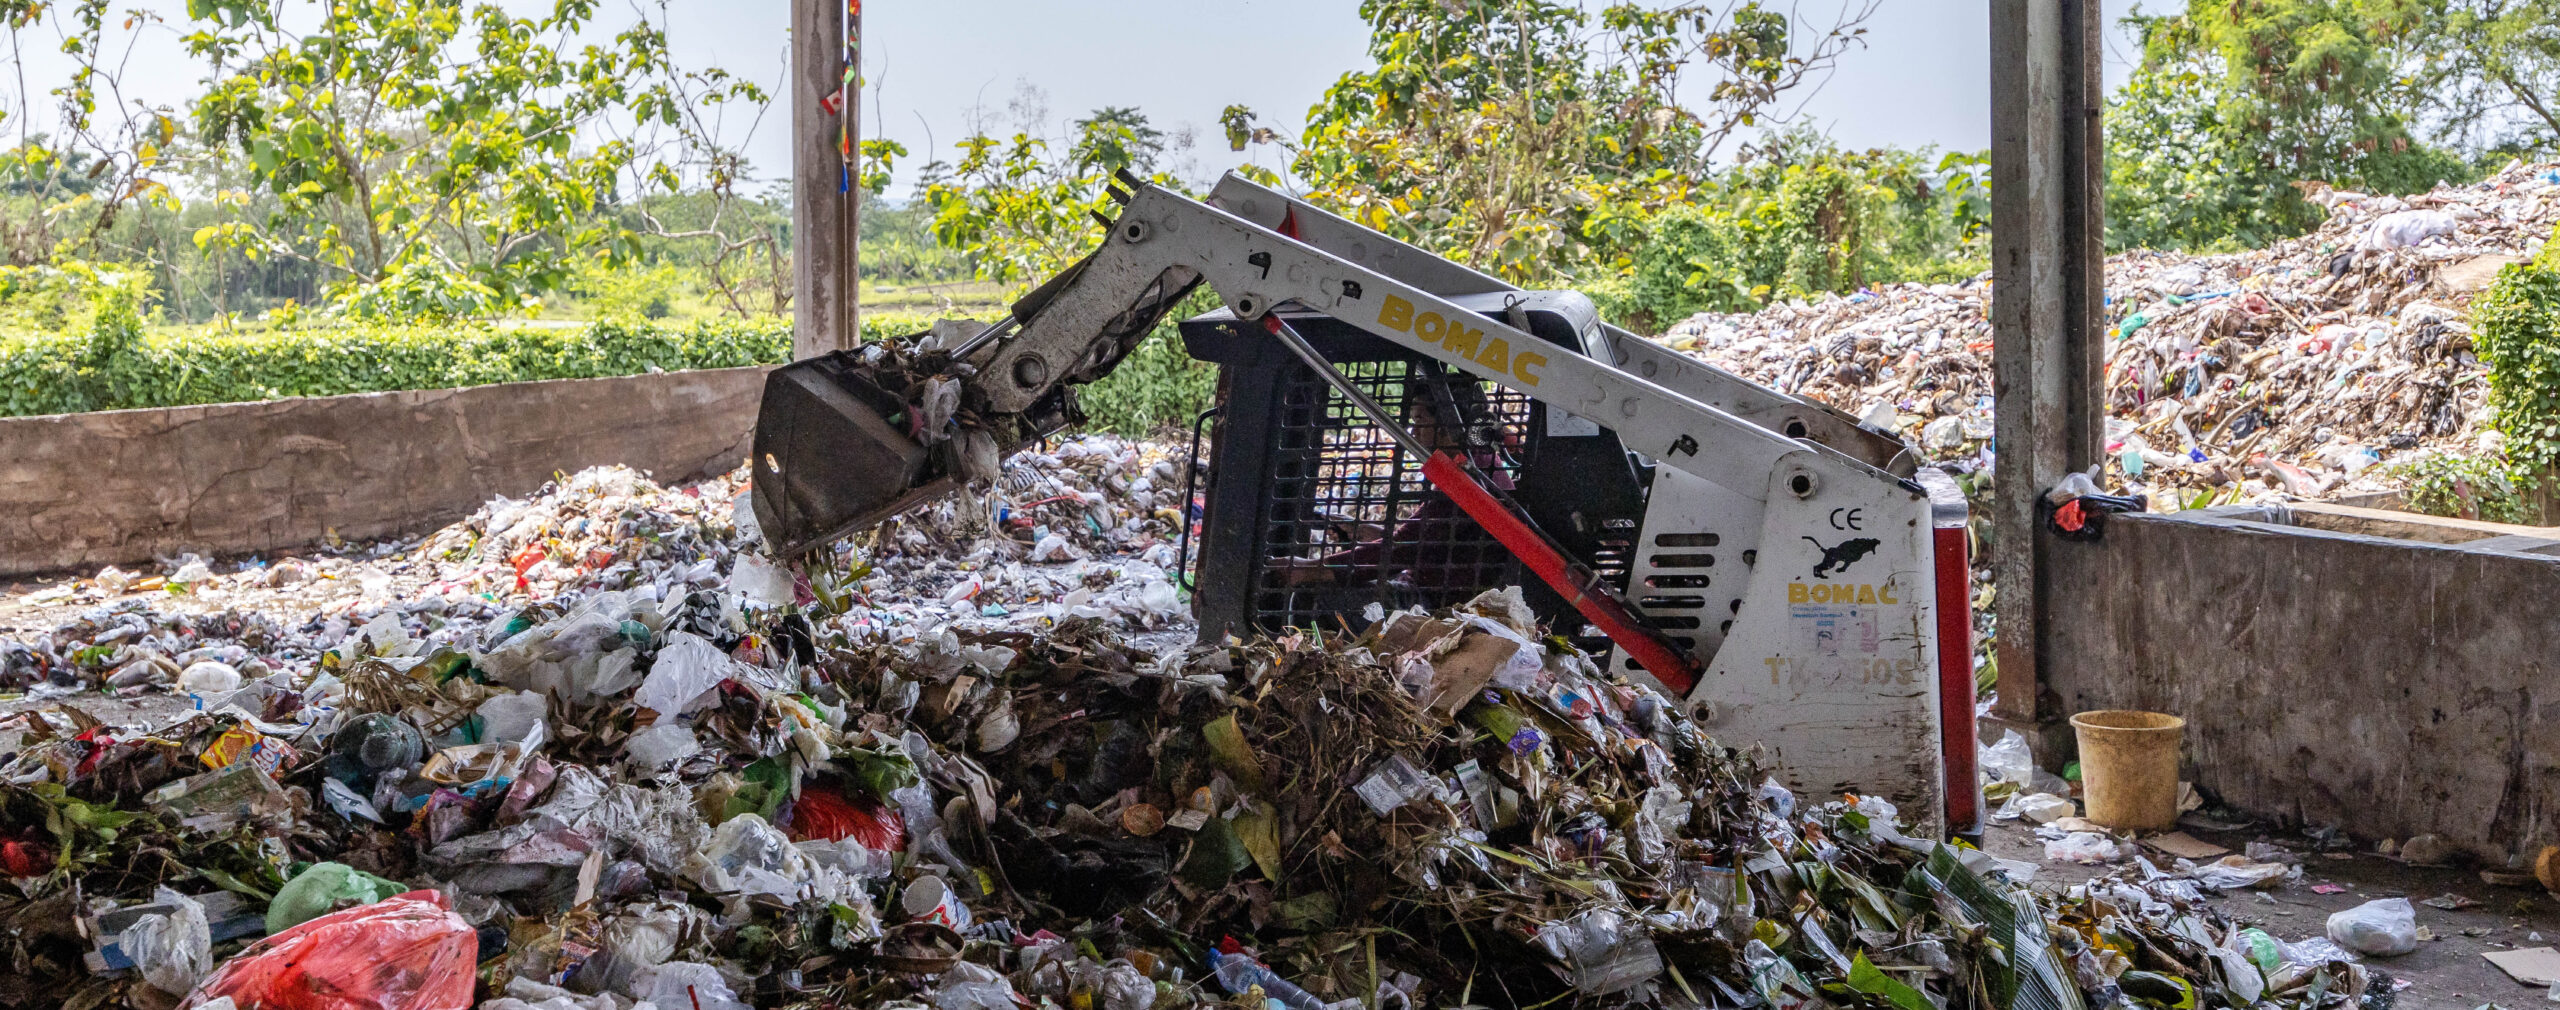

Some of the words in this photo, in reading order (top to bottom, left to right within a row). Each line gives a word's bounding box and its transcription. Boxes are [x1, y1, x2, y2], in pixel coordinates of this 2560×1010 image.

[1377, 294, 1548, 387] BOMAC
[1830, 508, 1861, 530] CE
[1788, 583, 1897, 605] BOMAC
